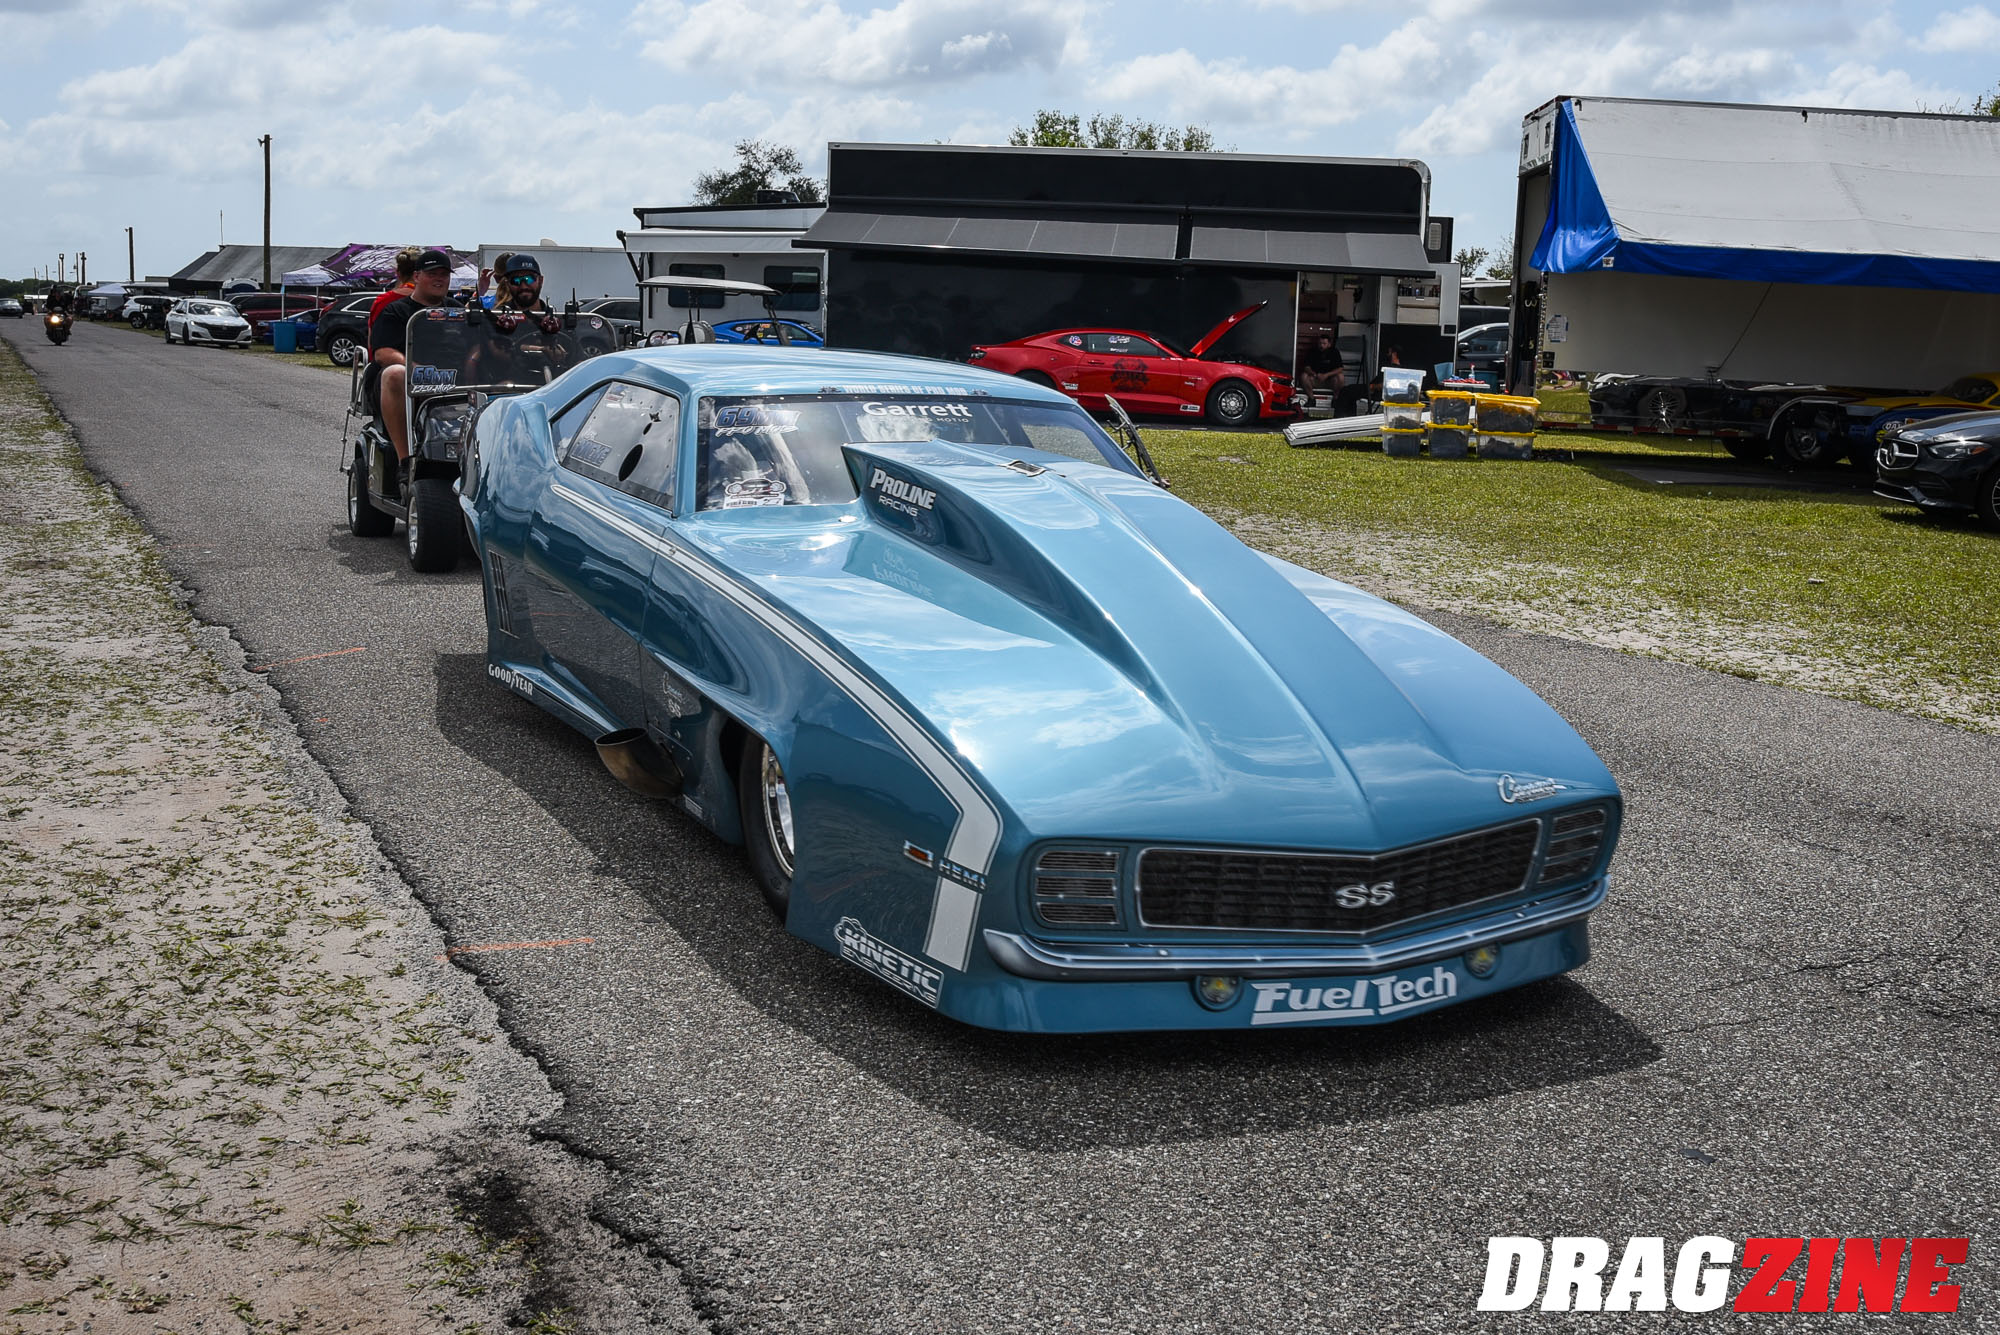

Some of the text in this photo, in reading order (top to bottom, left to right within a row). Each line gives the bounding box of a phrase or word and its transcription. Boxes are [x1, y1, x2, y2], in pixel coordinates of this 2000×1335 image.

[412, 366, 456, 386] 69MM
[926, 386, 945, 395] PRO
[862, 401, 973, 417] Garrett
[870, 468, 937, 510] PROLINE
[878, 495, 919, 517] RACING
[939, 858, 987, 890] HEMI
[1336, 880, 1397, 909] SS
[844, 928, 940, 994] KINETIC
